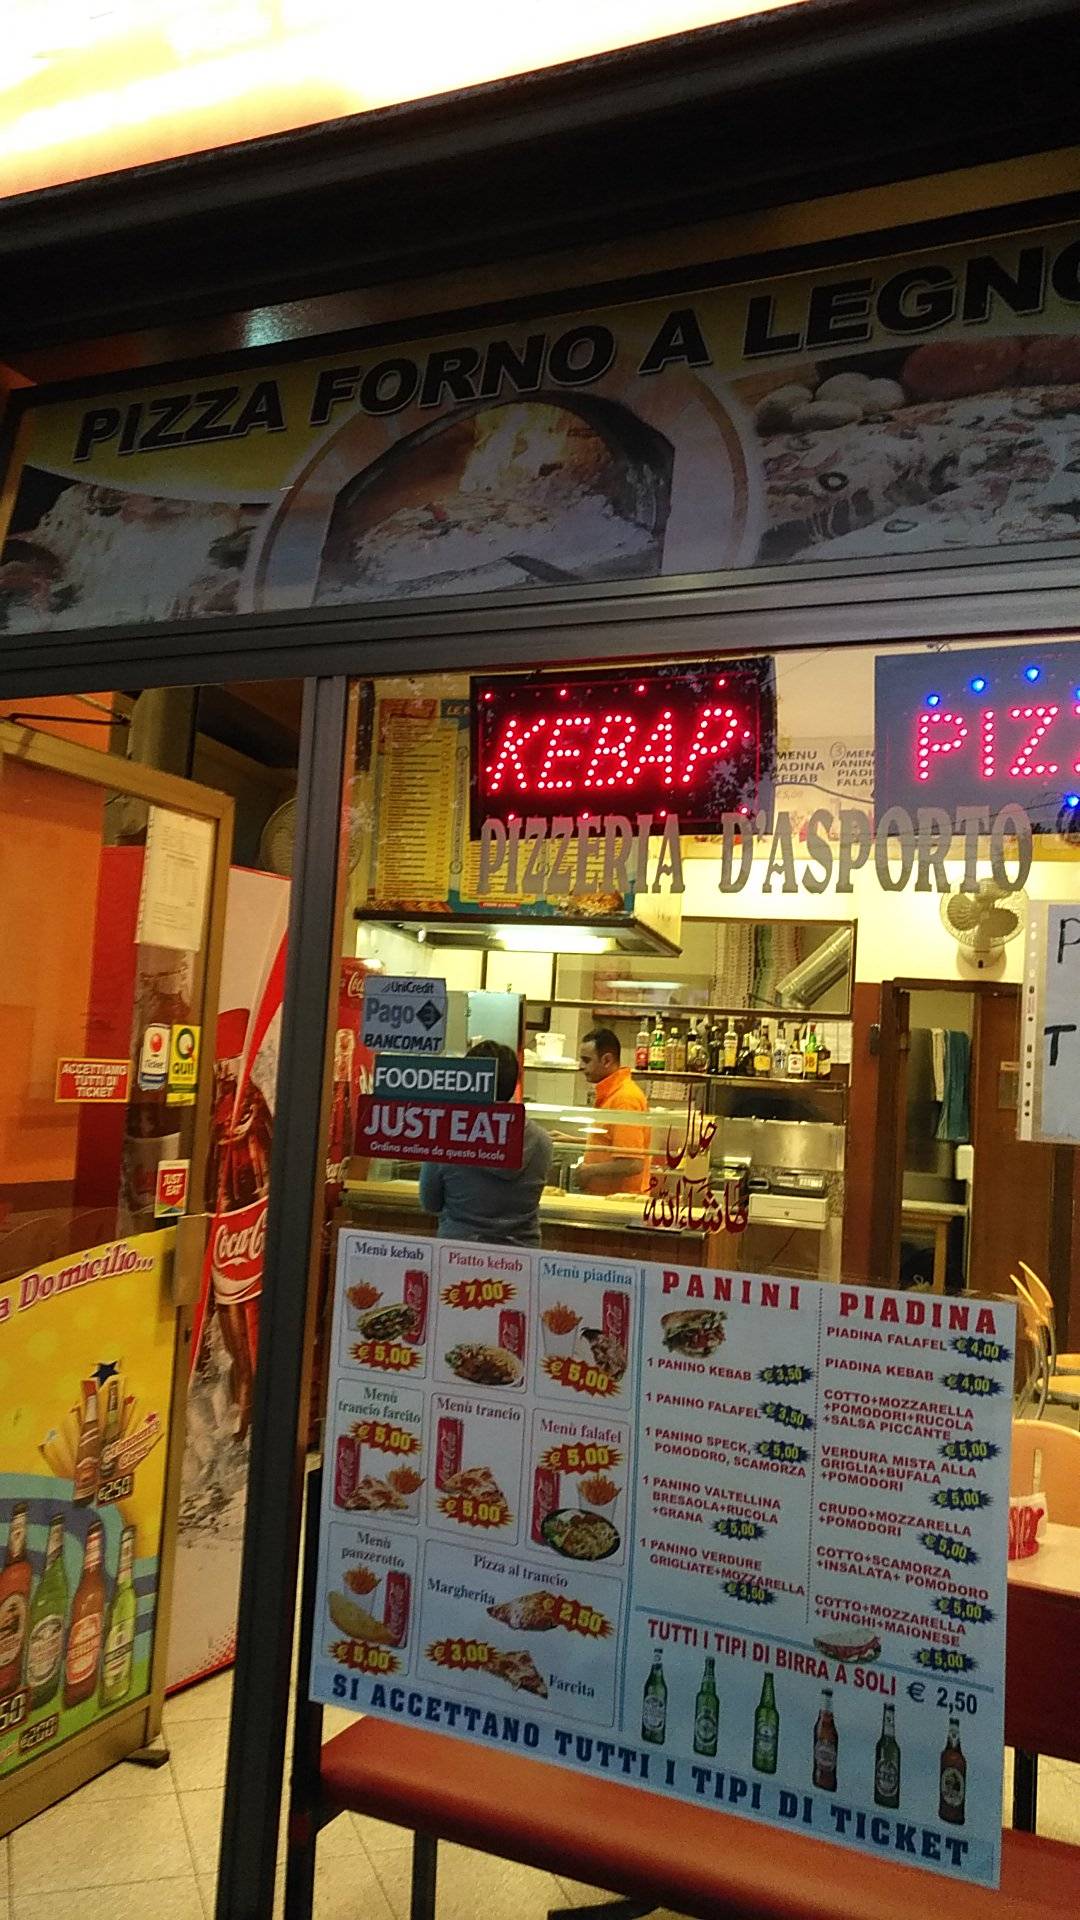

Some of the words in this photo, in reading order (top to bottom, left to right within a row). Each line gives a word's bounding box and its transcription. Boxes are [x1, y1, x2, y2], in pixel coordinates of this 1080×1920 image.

[73, 380, 288, 463] PIZZA
[309, 325, 614, 427] FORNO
[638, 309, 714, 376] A
[918, 704, 1080, 783] PIZ
[774, 762, 825, 771] ADINA
[838, 769, 873, 777] PIADI
[477, 812, 685, 895] PIZZERIA
[718, 802, 1033, 894] D'ASPORTO
[391, 981, 434, 994] UniCredit
[366, 998, 414, 1029] Pago
[364, 1033, 443, 1052] BANCOMAT
[61, 1063, 127, 1076] ACCETTIAMO
[74, 1075, 103, 1086] TUTTI
[375, 1066, 494, 1094] FOODEED.IT
[76, 1086, 115, 1098] TICKET
[363, 1104, 446, 1140] JUST
[449, 1110, 512, 1146] EAT
[370, 1141, 401, 1153] Ordina
[403, 1144, 430, 1156] online
[432, 1146, 444, 1157] da
[446, 1149, 477, 1160] questo
[478, 1149, 506, 1162] locale
[162, 1173, 185, 1187] JUST
[165, 1184, 183, 1197] EAT
[390, 1245, 425, 1261] kebab
[448, 1252, 484, 1268] Piatto
[487, 1256, 524, 1272] kebab
[543, 1262, 579, 1279] Menù
[583, 1267, 633, 1286] piadina
[465, 1284, 504, 1301] 7,00
[662, 1271, 800, 1310] PANINI
[839, 1292, 997, 1335] PIADINA
[826, 1326, 883, 1343] PIADINA
[887, 1333, 949, 1351] FALAFEL
[970, 1341, 999, 1359] 4,00
[374, 1347, 412, 1365] 5,00
[569, 1365, 609, 1390] 5,00
[648, 1357, 653, 1367] 1
[658, 1358, 705, 1374] PANINO
[709, 1366, 752, 1381] KEBAB
[777, 1368, 802, 1380] 3,50
[825, 1358, 881, 1375] PIADINA
[886, 1366, 934, 1381] KEBAB
[961, 1377, 990, 1392] 4,00
[338, 1400, 381, 1417] trancio
[383, 1406, 421, 1424] farcito
[476, 1403, 521, 1422] trancio
[646, 1392, 651, 1402] 1
[656, 1393, 704, 1409] PANINO
[708, 1401, 761, 1419] FALAFEL
[824, 1389, 974, 1419] COTTO+MOZZARELLA
[778, 1409, 804, 1426] 3,50
[823, 1415, 876, 1431] +SALSA
[879, 1422, 951, 1441] PICCANTE
[824, 1403, 974, 1432] +POMODORI+RUCOLA
[375, 1427, 412, 1449] 5,00
[581, 1425, 622, 1444] falafel
[645, 1427, 650, 1437] 1
[655, 1428, 703, 1443] PANINO
[567, 1451, 609, 1467] 5,00
[655, 1443, 731, 1466] POMODORO,
[734, 1456, 806, 1478] SCAMORZA
[773, 1445, 799, 1459] 5,00
[959, 1444, 987, 1456] 5,00
[820, 1458, 941, 1484] GRIGLIA+BUFALA
[821, 1446, 888, 1464] VERDURA
[892, 1456, 936, 1471] MISTA
[940, 1462, 977, 1478] ALLA
[643, 1475, 649, 1485] 1
[653, 1477, 701, 1493] PANINO
[704, 1486, 781, 1510] VALTELLINA
[821, 1471, 903, 1492] +POMODORI
[462, 1498, 501, 1523] 5,00
[652, 1491, 778, 1524] BRESAOLA+RUCOLA
[952, 1493, 979, 1505] 5,00
[652, 1506, 703, 1523] +GRANA
[818, 1502, 973, 1537] CRUDO+MOZZARELLA
[730, 1523, 755, 1536] 5,00
[819, 1516, 902, 1537] +POMODORI
[341, 1547, 405, 1569] panzerotto
[640, 1537, 646, 1548] 1
[650, 1540, 698, 1557] PANINO
[702, 1549, 762, 1571] VERDURE
[939, 1539, 967, 1560] 5,00
[474, 1554, 505, 1576] Pizza
[509, 1564, 520, 1578] al
[523, 1566, 568, 1589] trancio
[816, 1546, 952, 1580] COTTO+SCAMORZA
[650, 1554, 805, 1596] GRIGLIATE+MOZZARELLA
[816, 1560, 900, 1582] +INSALATA+
[905, 1574, 989, 1600] POMODORO
[427, 1577, 496, 1606] Margherita
[739, 1585, 765, 1600] 3,50
[559, 1604, 602, 1634] 2,50
[815, 1594, 966, 1635] COTTO+MOZZARELLA
[953, 1600, 982, 1618] 5,00
[814, 1608, 960, 1647] +FUNGHI+MAIONESE
[353, 1646, 391, 1670] 5,00
[451, 1643, 489, 1662] 3,00
[935, 1652, 963, 1668] 5,00
[648, 1619, 697, 1647] TUTTI
[704, 1631, 709, 1649] I
[714, 1633, 747, 1658] TIPI
[753, 1643, 770, 1664] DI
[775, 1648, 829, 1680] BIRRA
[835, 1663, 847, 1684] A
[853, 1667, 896, 1696] SOLI
[907, 1681, 925, 1703] €
[936, 1686, 978, 1715] 2,50
[549, 1675, 595, 1698] Farcita
[332, 1673, 359, 1700] SI
[370, 1683, 540, 1748] ACCETTANO
[554, 1729, 650, 1779] TUTTI
[665, 1758, 676, 1786] I
[691, 1766, 761, 1810] TIPI
[778, 1789, 814, 1824] DI
[830, 1804, 970, 1868] TICKET
